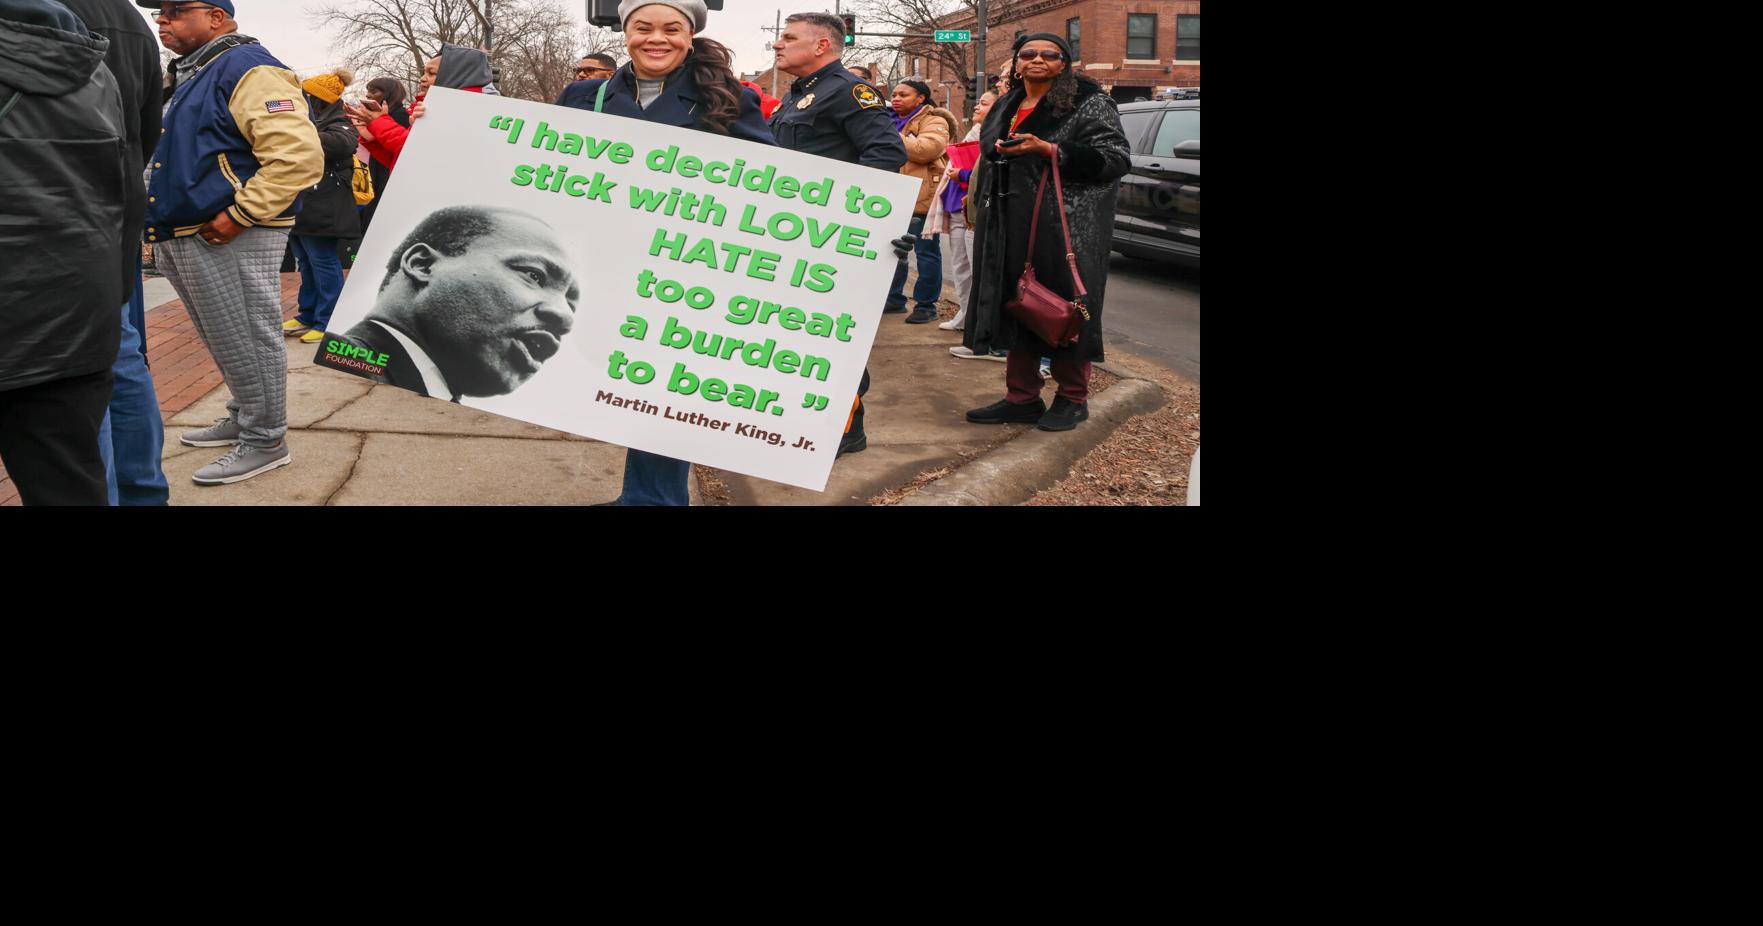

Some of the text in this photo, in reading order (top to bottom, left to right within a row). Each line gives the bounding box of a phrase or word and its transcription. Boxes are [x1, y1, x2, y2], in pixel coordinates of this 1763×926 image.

[531, 119, 634, 165] have
[645, 144, 834, 207] decided
[844, 184, 893, 219] to
[510, 161, 878, 261] stick with LOVE.
[648, 227, 838, 293] HATE IS
[635, 267, 857, 343] too great
[325, 353, 381, 374] FOUNDATION
[326, 340, 390, 367] SIMPLE
[607, 349, 656, 385] to
[619, 313, 831, 382] a burden
[594, 389, 816, 452] Martin Luther King, Jr.
